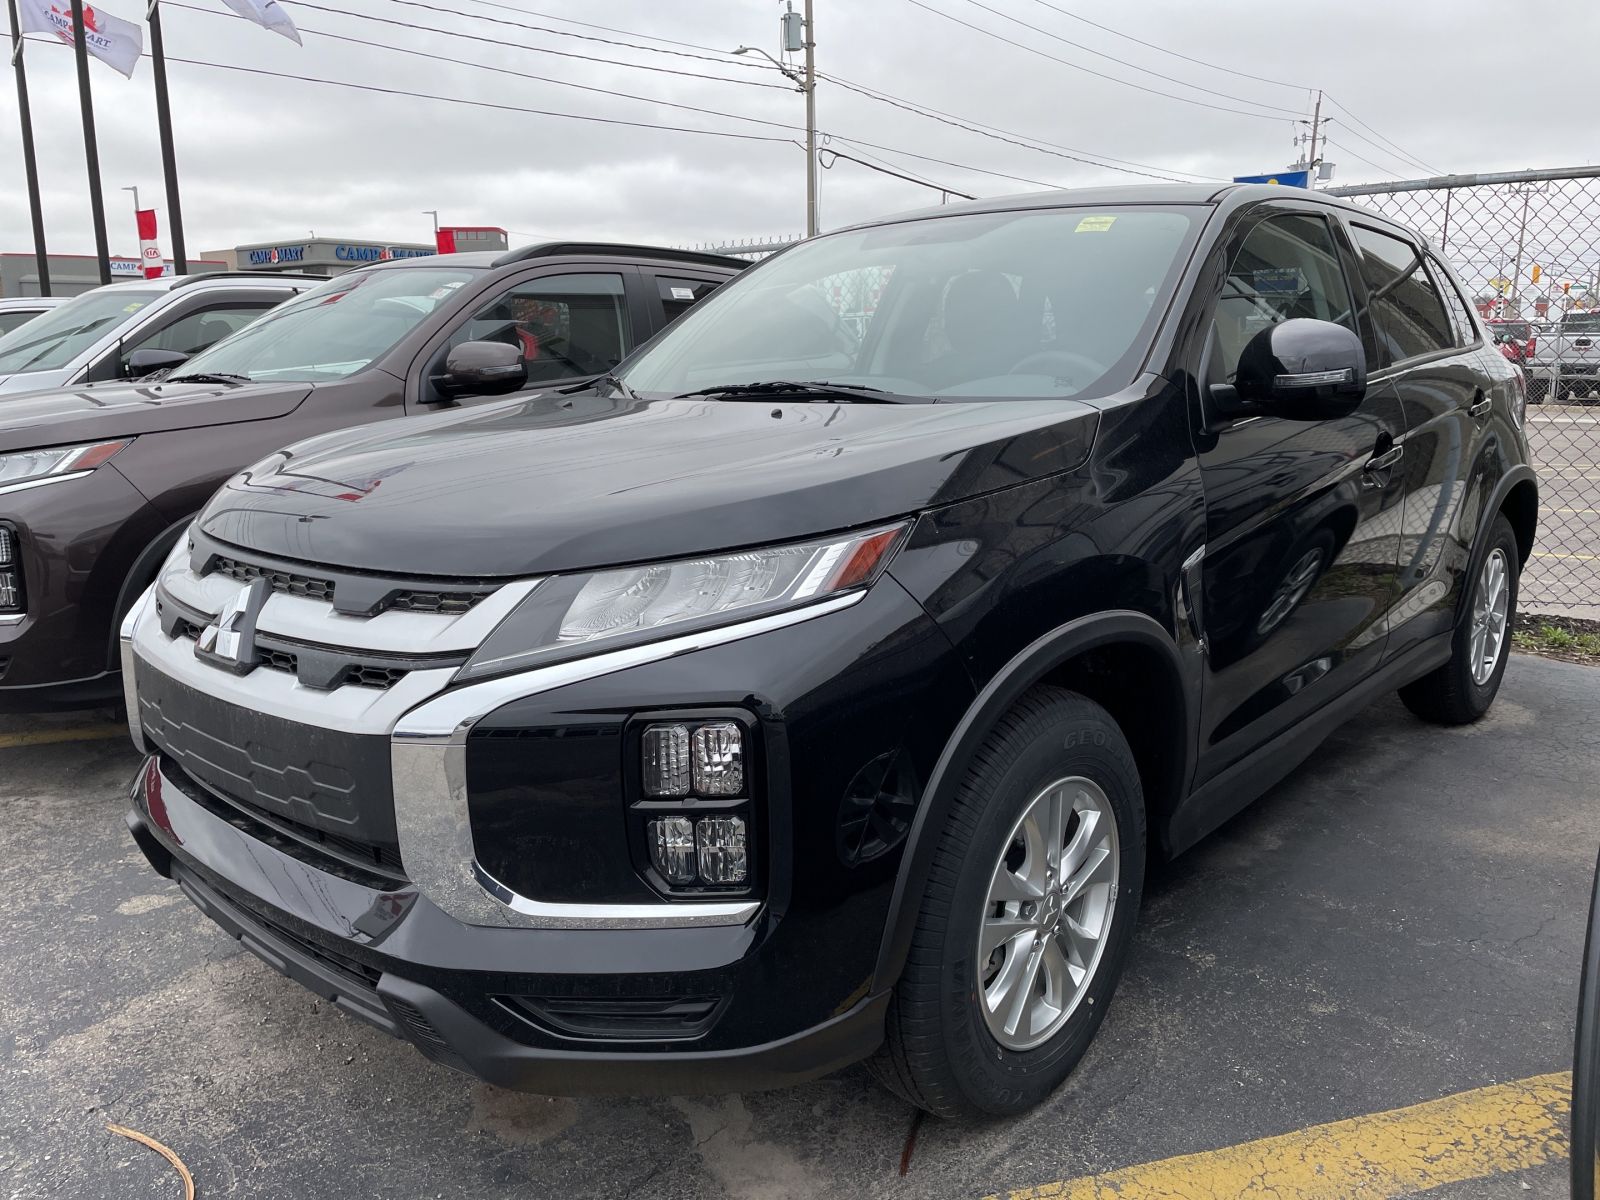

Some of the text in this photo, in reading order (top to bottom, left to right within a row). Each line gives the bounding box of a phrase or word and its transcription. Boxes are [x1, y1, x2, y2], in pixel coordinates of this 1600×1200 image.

[84, 31, 112, 47] ART
[249, 246, 304, 265] CAMP MART
[335, 243, 380, 261] CAMP
[110, 262, 136, 271] CAMP
